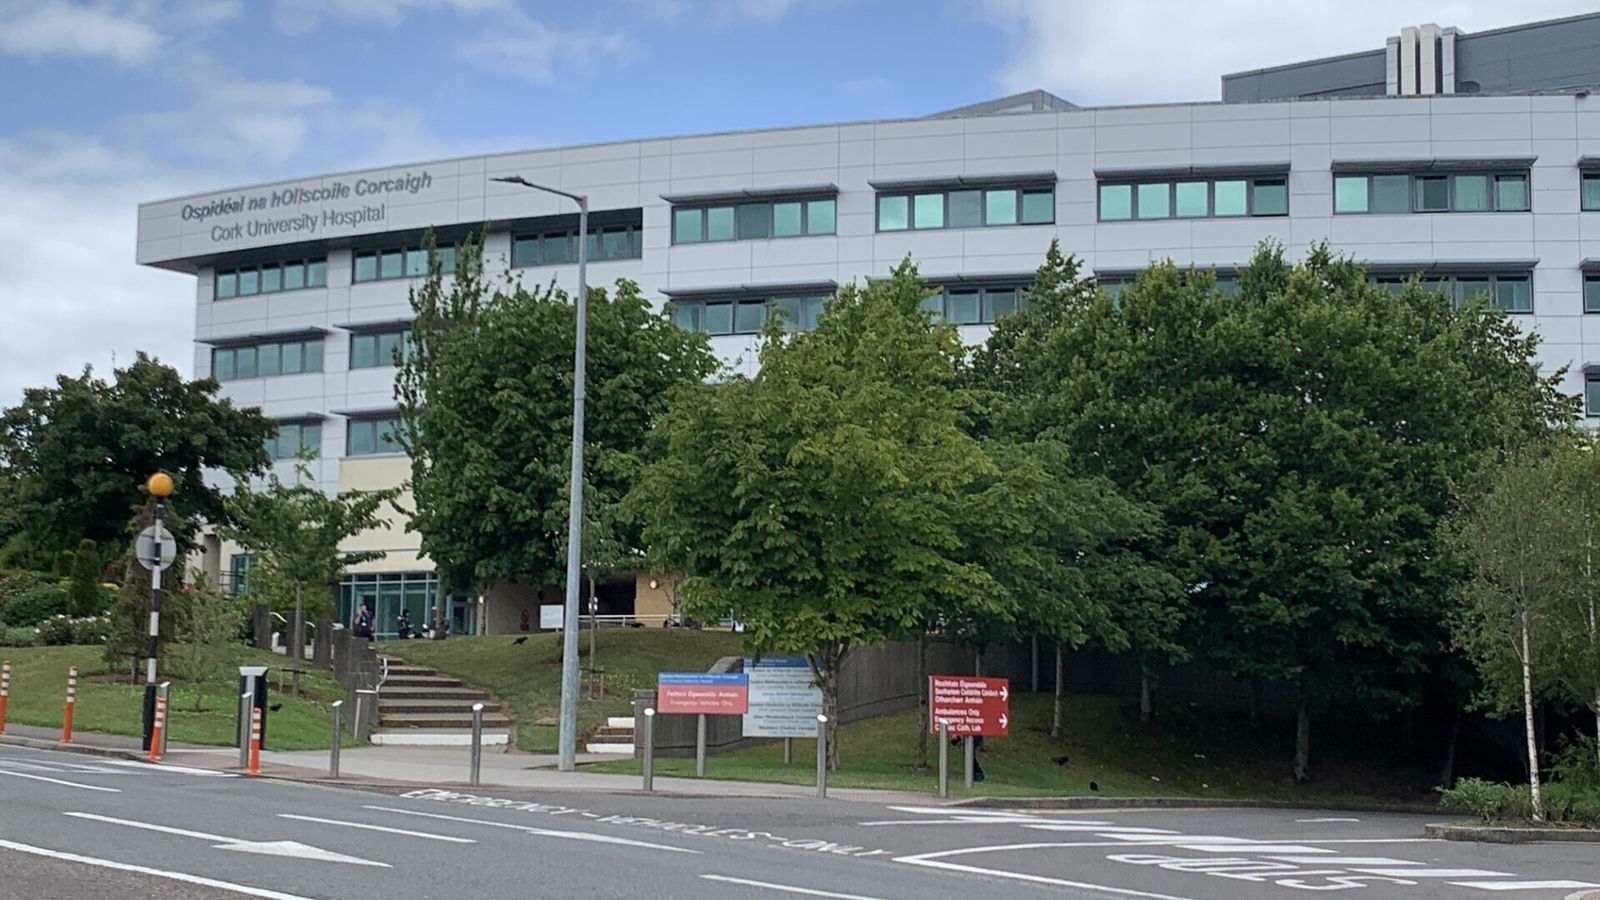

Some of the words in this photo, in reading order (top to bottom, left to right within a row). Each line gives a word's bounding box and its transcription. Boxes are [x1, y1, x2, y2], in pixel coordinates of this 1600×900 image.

[181, 197, 245, 222] Ospidéal
[248, 198, 266, 210] na
[271, 182, 350, 208] hOllscoile
[355, 171, 432, 196] Corcaigh
[211, 223, 242, 242] Cork
[247, 214, 319, 238] University
[322, 203, 385, 228] Hospital
[934, 707, 967, 716] Ambulances
[968, 707, 980, 717] Only
[965, 716, 984, 724] Access
